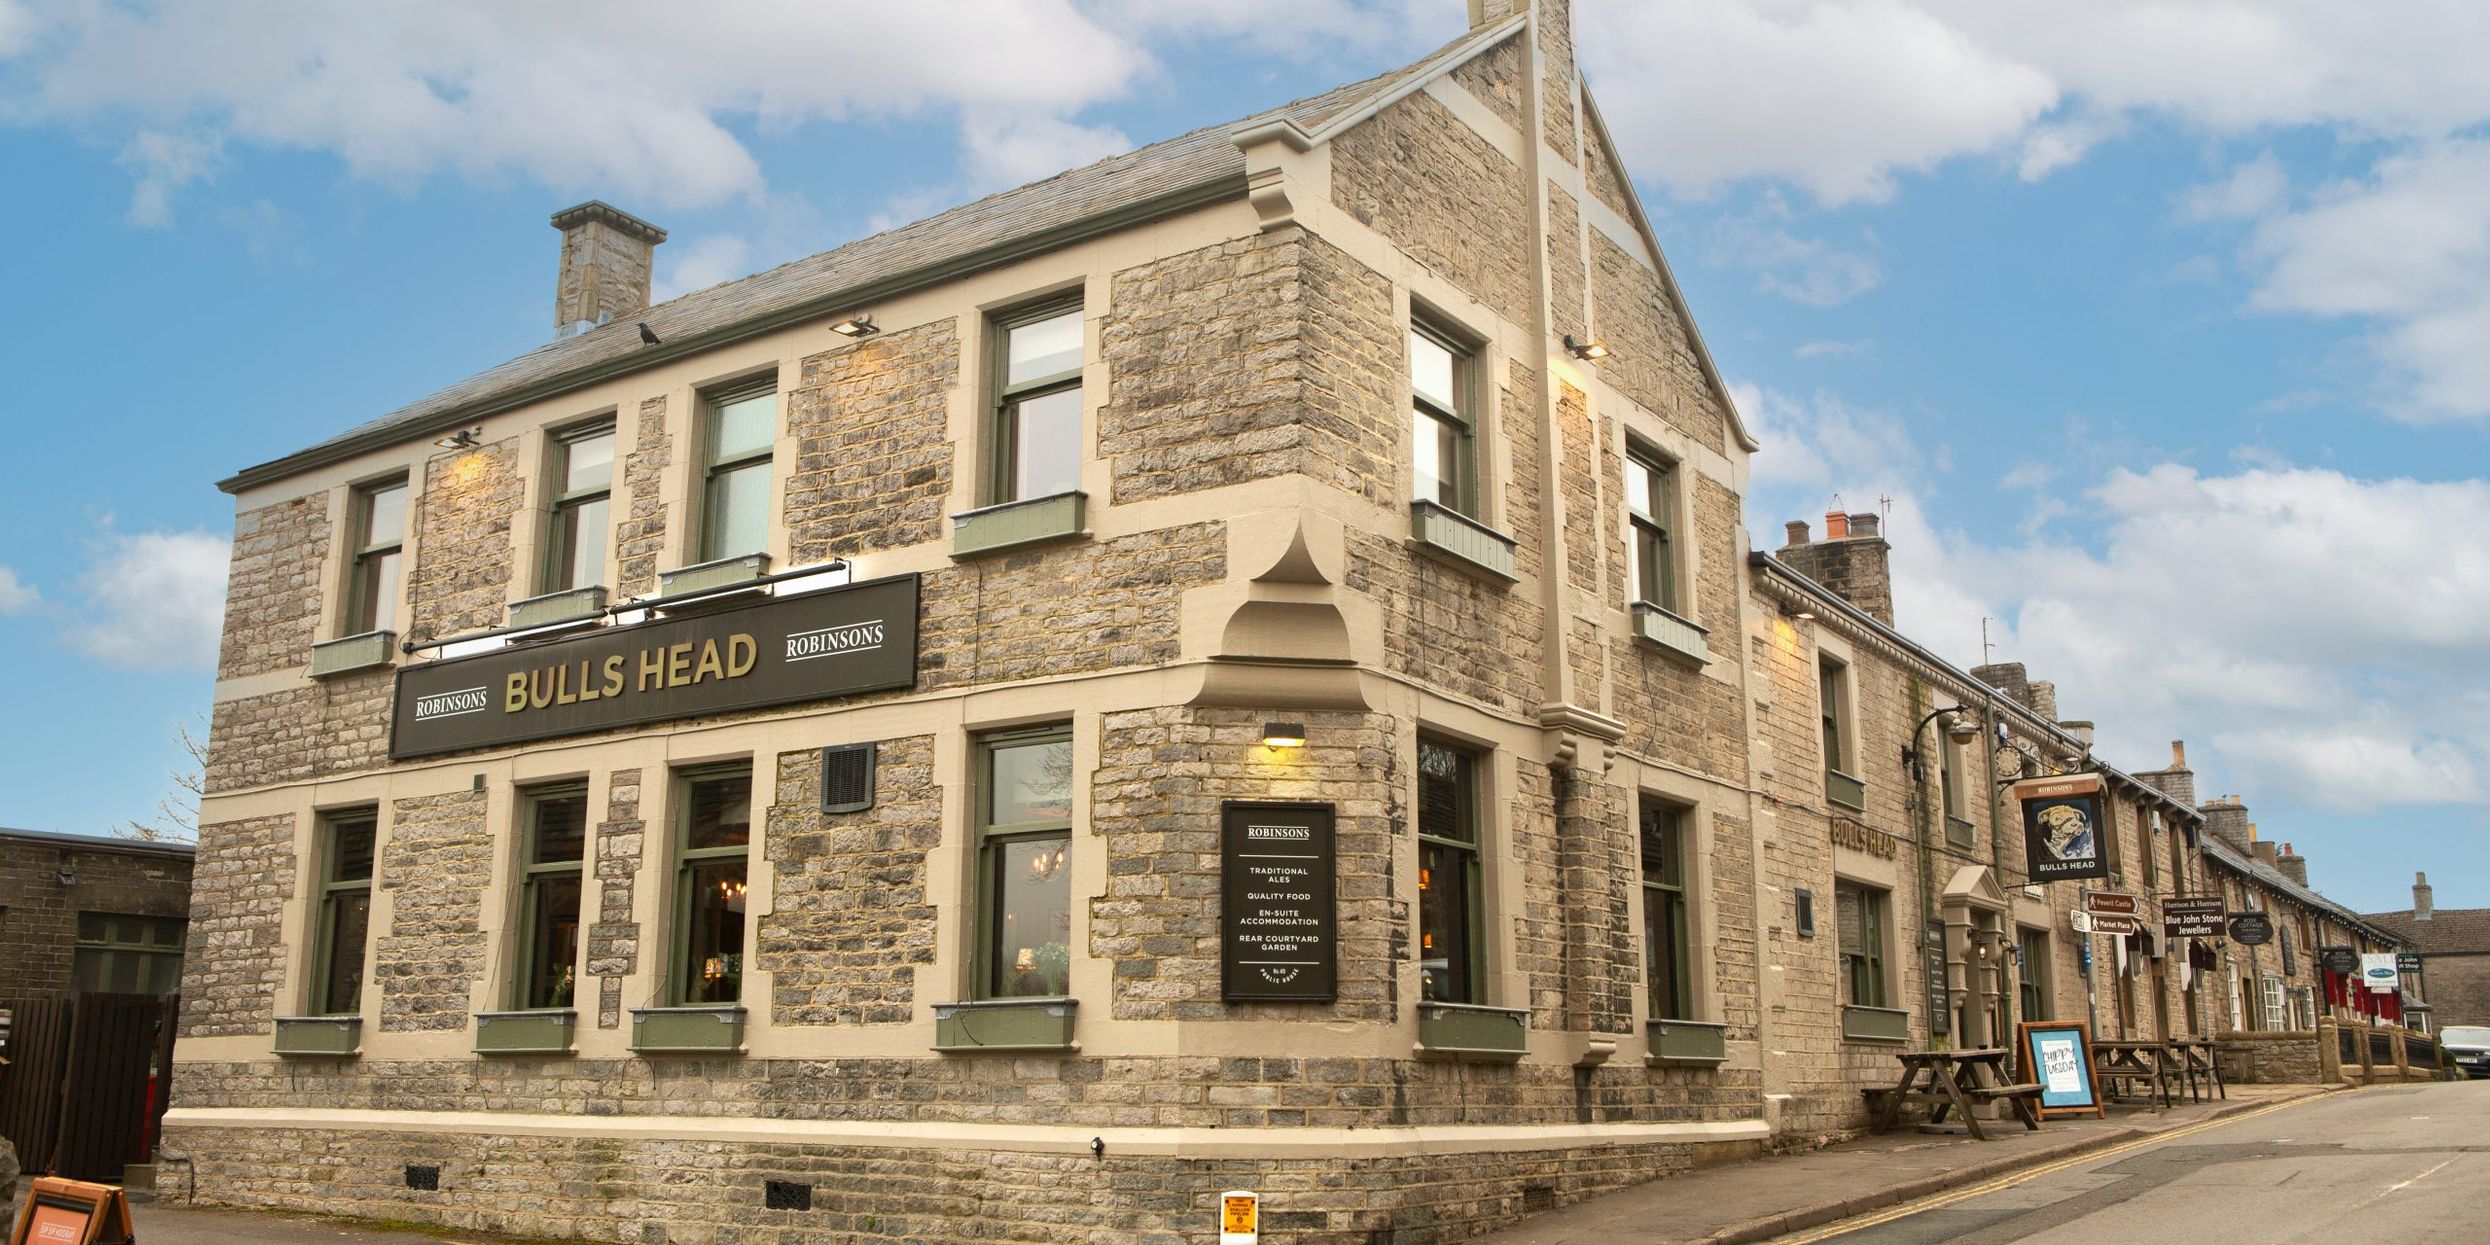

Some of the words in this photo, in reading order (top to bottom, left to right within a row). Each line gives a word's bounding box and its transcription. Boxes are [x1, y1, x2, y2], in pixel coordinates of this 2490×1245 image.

[786, 624, 884, 659] ROBINSONS
[505, 655, 625, 714] BULLS
[638, 633, 758, 692] HEAD
[415, 690, 487, 719] ROBINSONS
[2038, 784, 2073, 793] ROBINSONS
[1248, 827, 1310, 838] ROBINSONS
[1832, 819, 1867, 851] BULLS
[1867, 829, 1896, 860] HEAD
[1250, 867, 1308, 875] TRADITIONAL
[2039, 863, 2068, 872] BULLS
[2070, 861, 2096, 870] HEAD
[1247, 892, 1284, 900] QUALITY
[2115, 900, 2131, 908] Castle
[1259, 909, 1299, 917] EN-SUITE
[1240, 917, 1319, 926] ACCOMMODATION
[2100, 920, 2116, 928] Market
[2165, 915, 2181, 925] Blue
[2184, 914, 2200, 924] John
[2202, 914, 2223, 923] Stone
[2178, 925, 2212, 935] Jewellers
[1265, 935, 1319, 943] COURTYARD
[1259, 967, 1280, 984] PUBLIC
[1282, 967, 1299, 983] HOUSE
[2043, 1047, 2075, 1063] CHIPPY
[2043, 1059, 2079, 1075] TUESDAY
